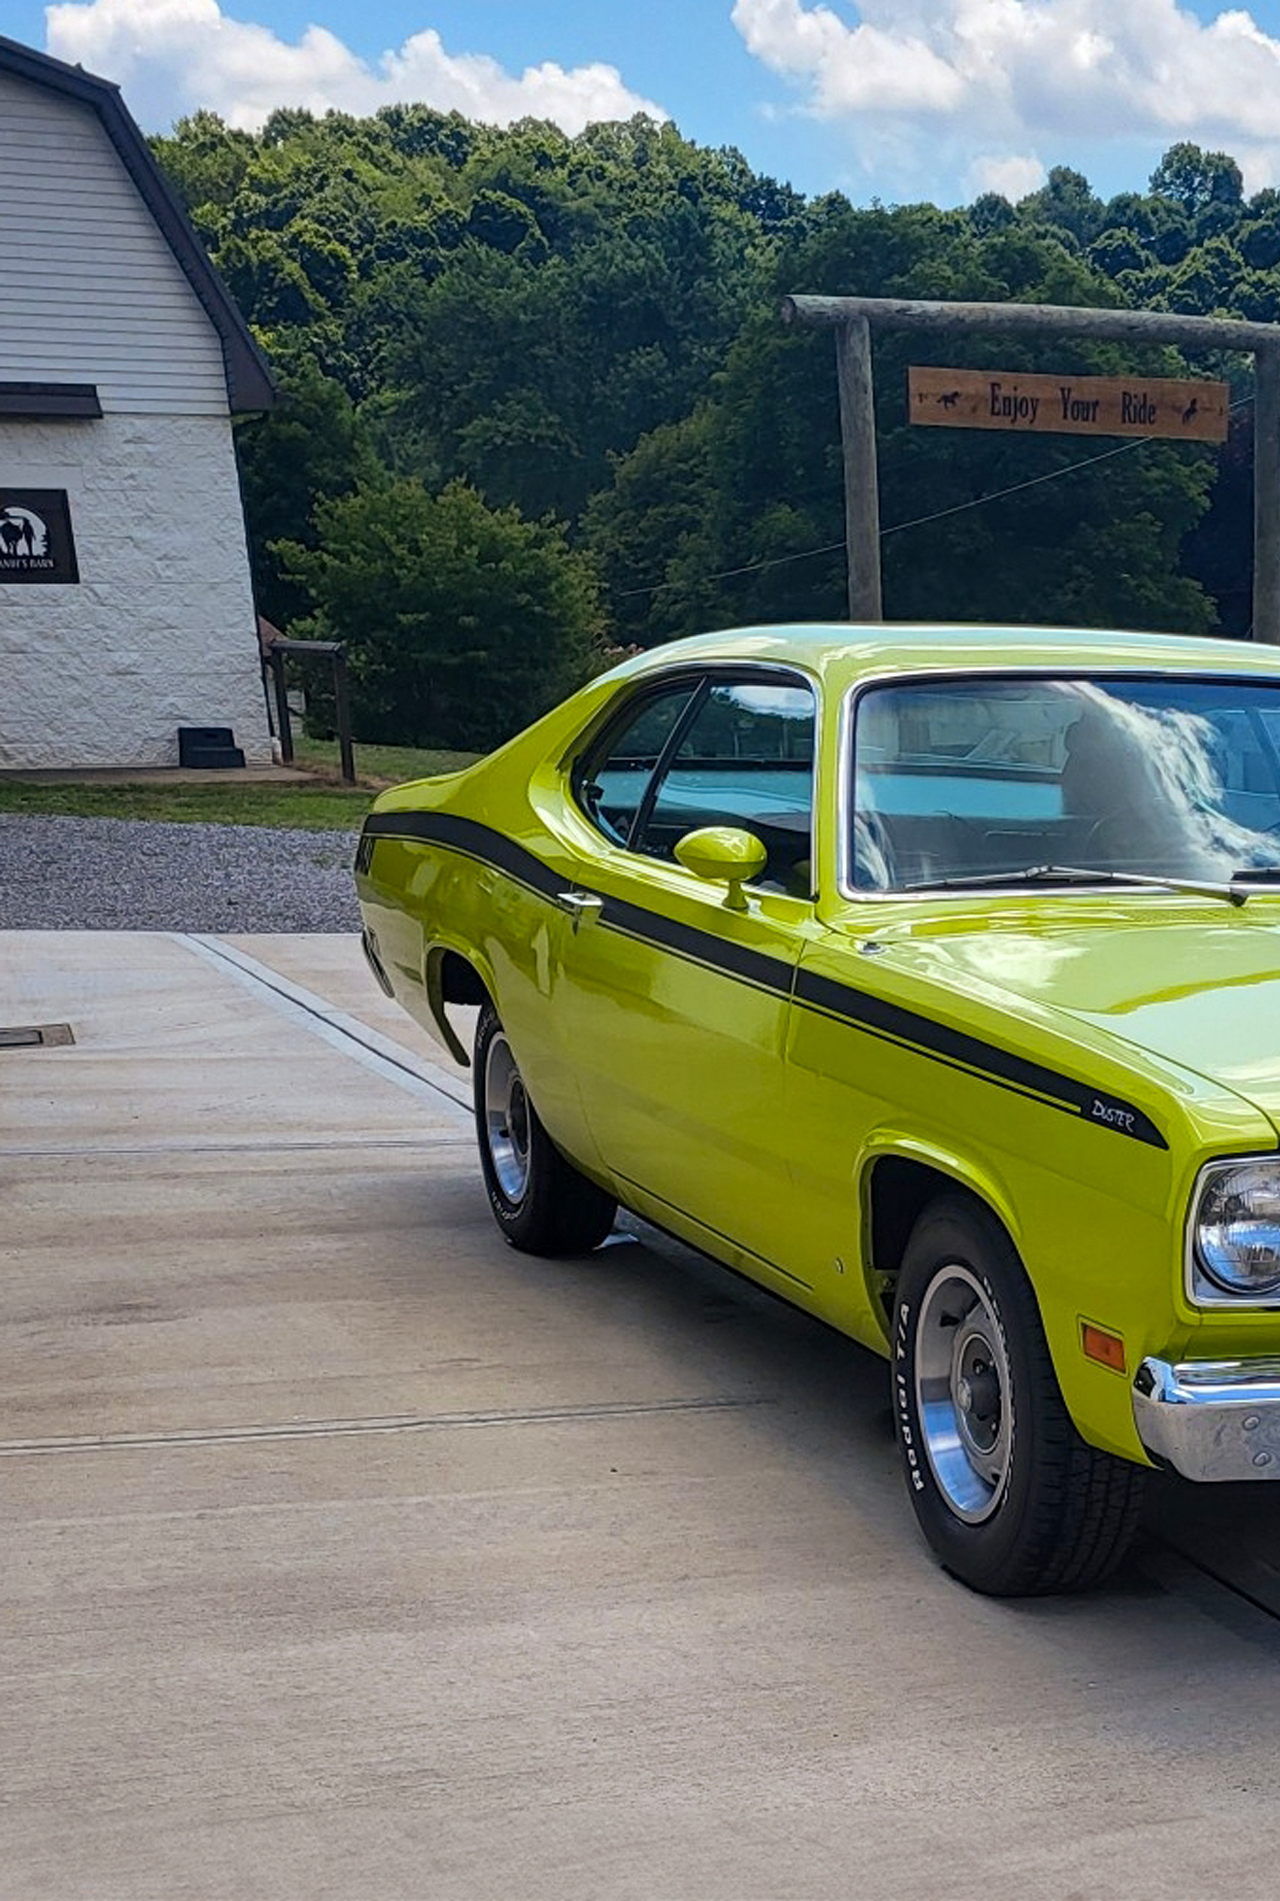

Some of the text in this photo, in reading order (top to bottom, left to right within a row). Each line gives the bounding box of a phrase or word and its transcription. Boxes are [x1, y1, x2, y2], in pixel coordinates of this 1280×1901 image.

[990, 382, 1156, 425] Enjoy Your Ride
[1092, 1099, 1135, 1133] DUSTER
[897, 1303, 924, 1490] Radial T/A
